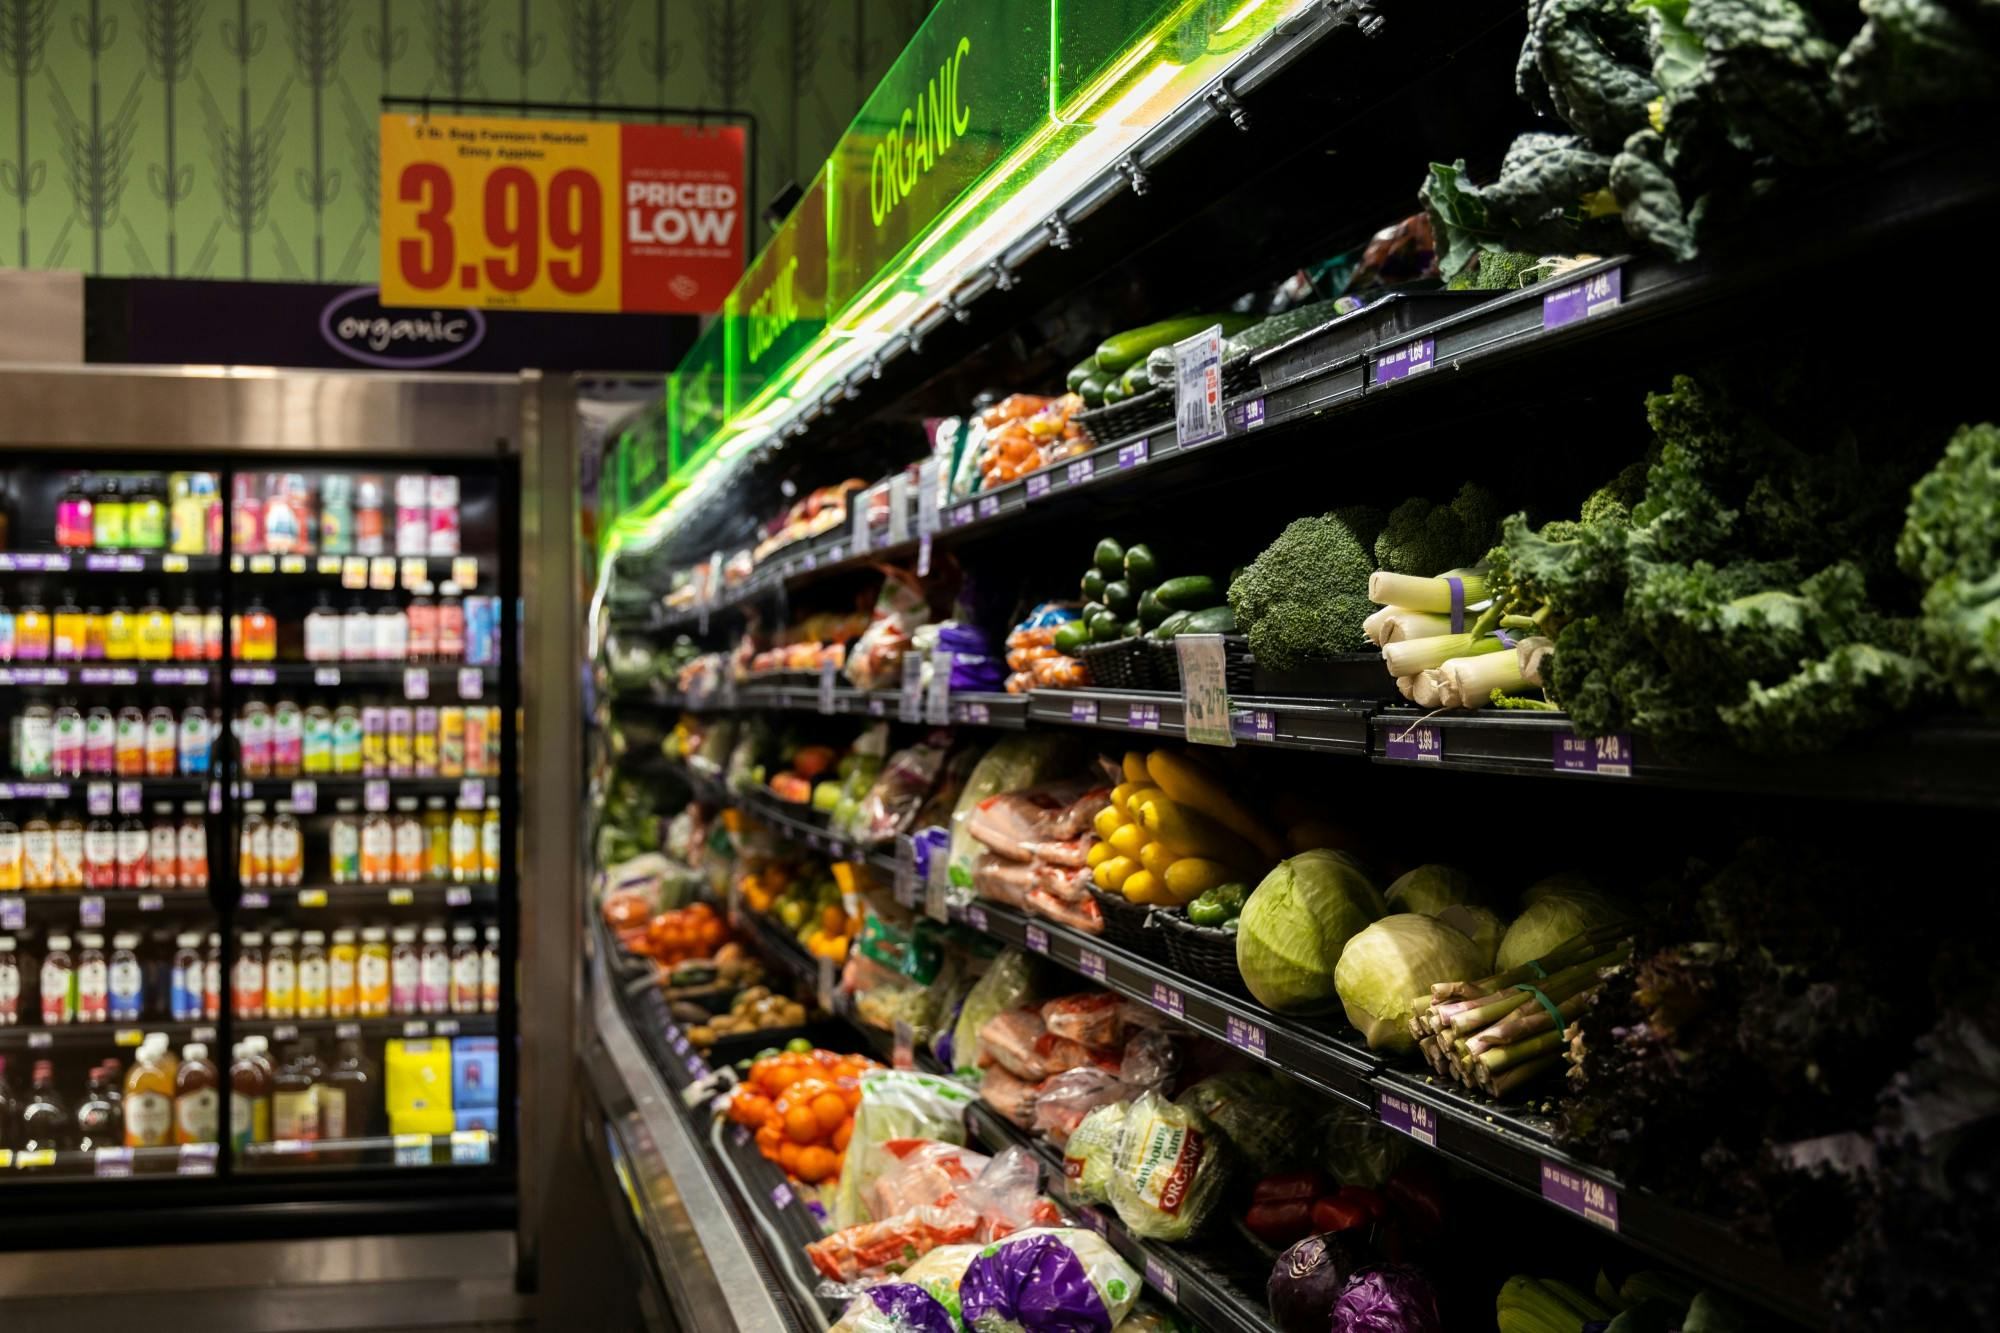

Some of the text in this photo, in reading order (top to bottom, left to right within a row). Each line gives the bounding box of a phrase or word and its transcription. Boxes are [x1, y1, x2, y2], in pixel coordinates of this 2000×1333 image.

[871, 37, 970, 226] ORGANIC
[627, 181, 736, 209] PRICED
[399, 162, 604, 295] 3.99
[628, 209, 736, 246] LOW
[338, 311, 467, 351] organic
[1163, 1129, 1184, 1161] Farm
[1164, 1134, 1200, 1208] ORGANIC
